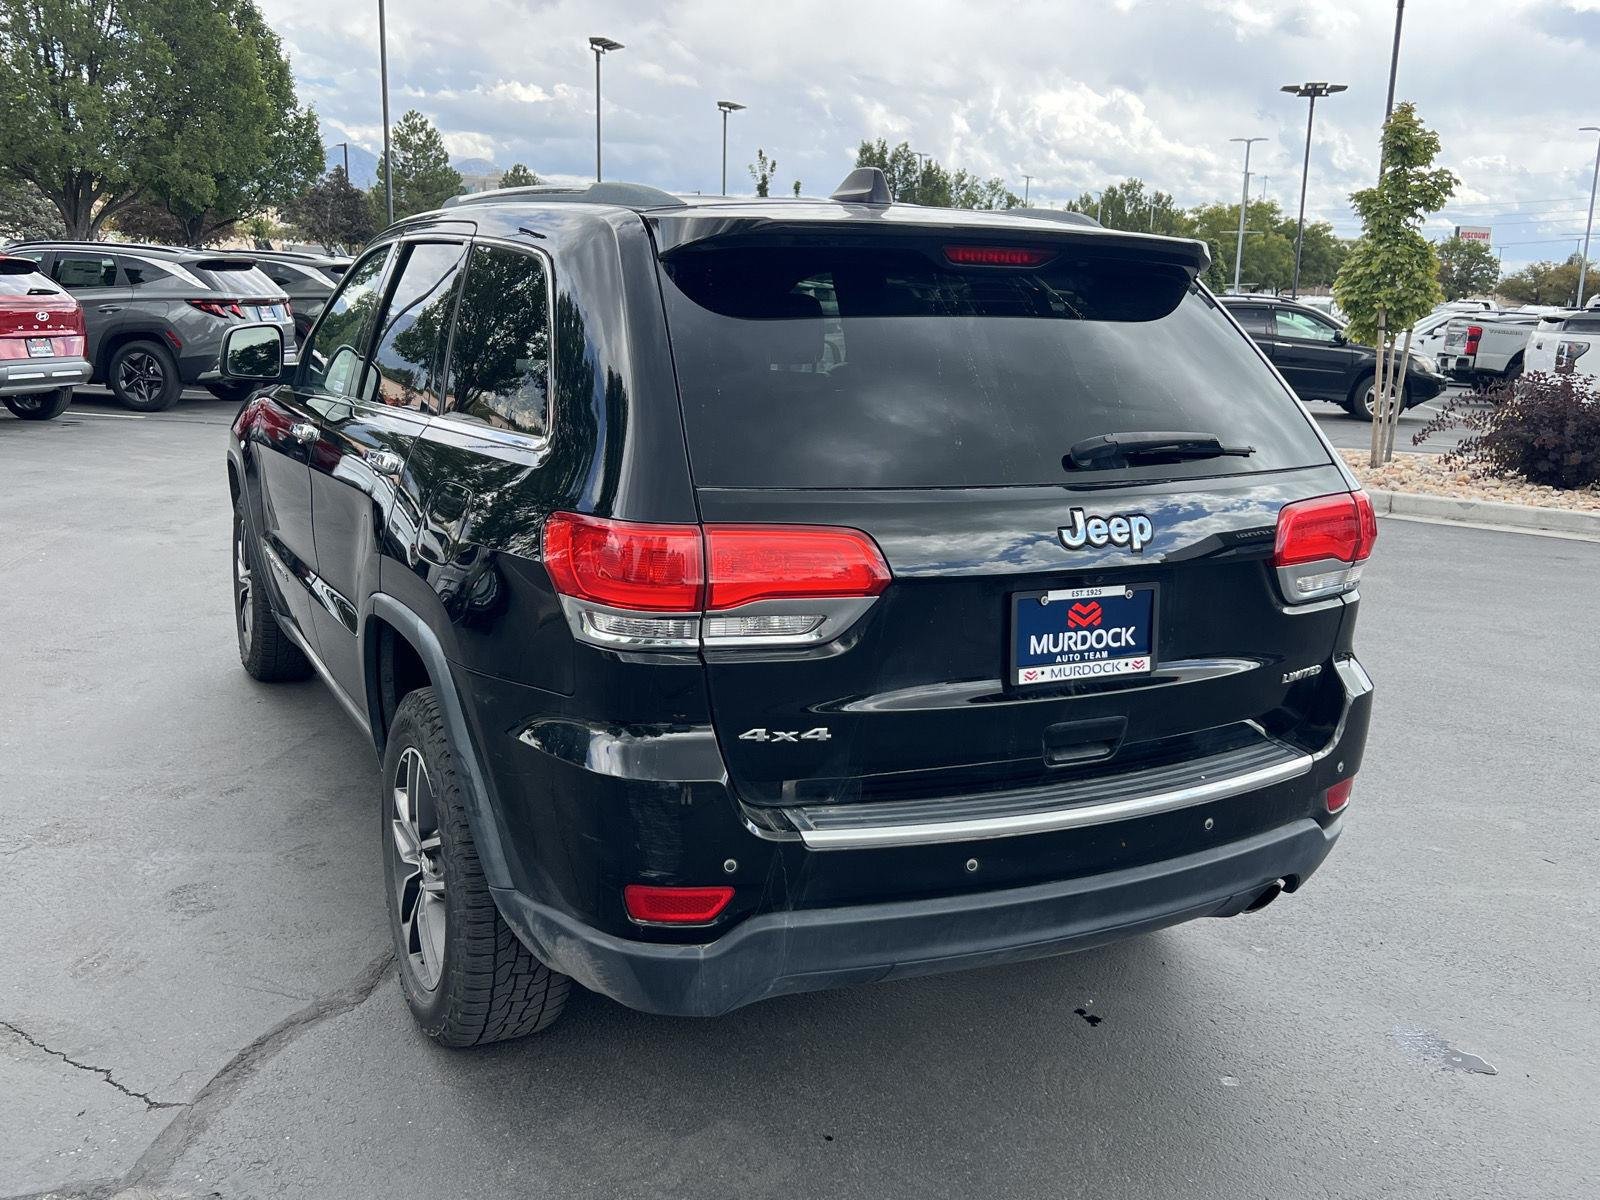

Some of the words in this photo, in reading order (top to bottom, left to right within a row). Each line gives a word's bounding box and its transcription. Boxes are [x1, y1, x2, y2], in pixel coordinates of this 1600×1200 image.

[1059, 508, 1152, 552] Jeep
[1071, 590, 1085, 598] EST.
[1086, 588, 1102, 597] 1925
[1029, 626, 1136, 655] MURDOCK
[1055, 653, 1081, 663] AUTO
[1084, 650, 1109, 660] TEAM
[1050, 661, 1121, 679] MURDOCK
[738, 727, 832, 743] 4x4
